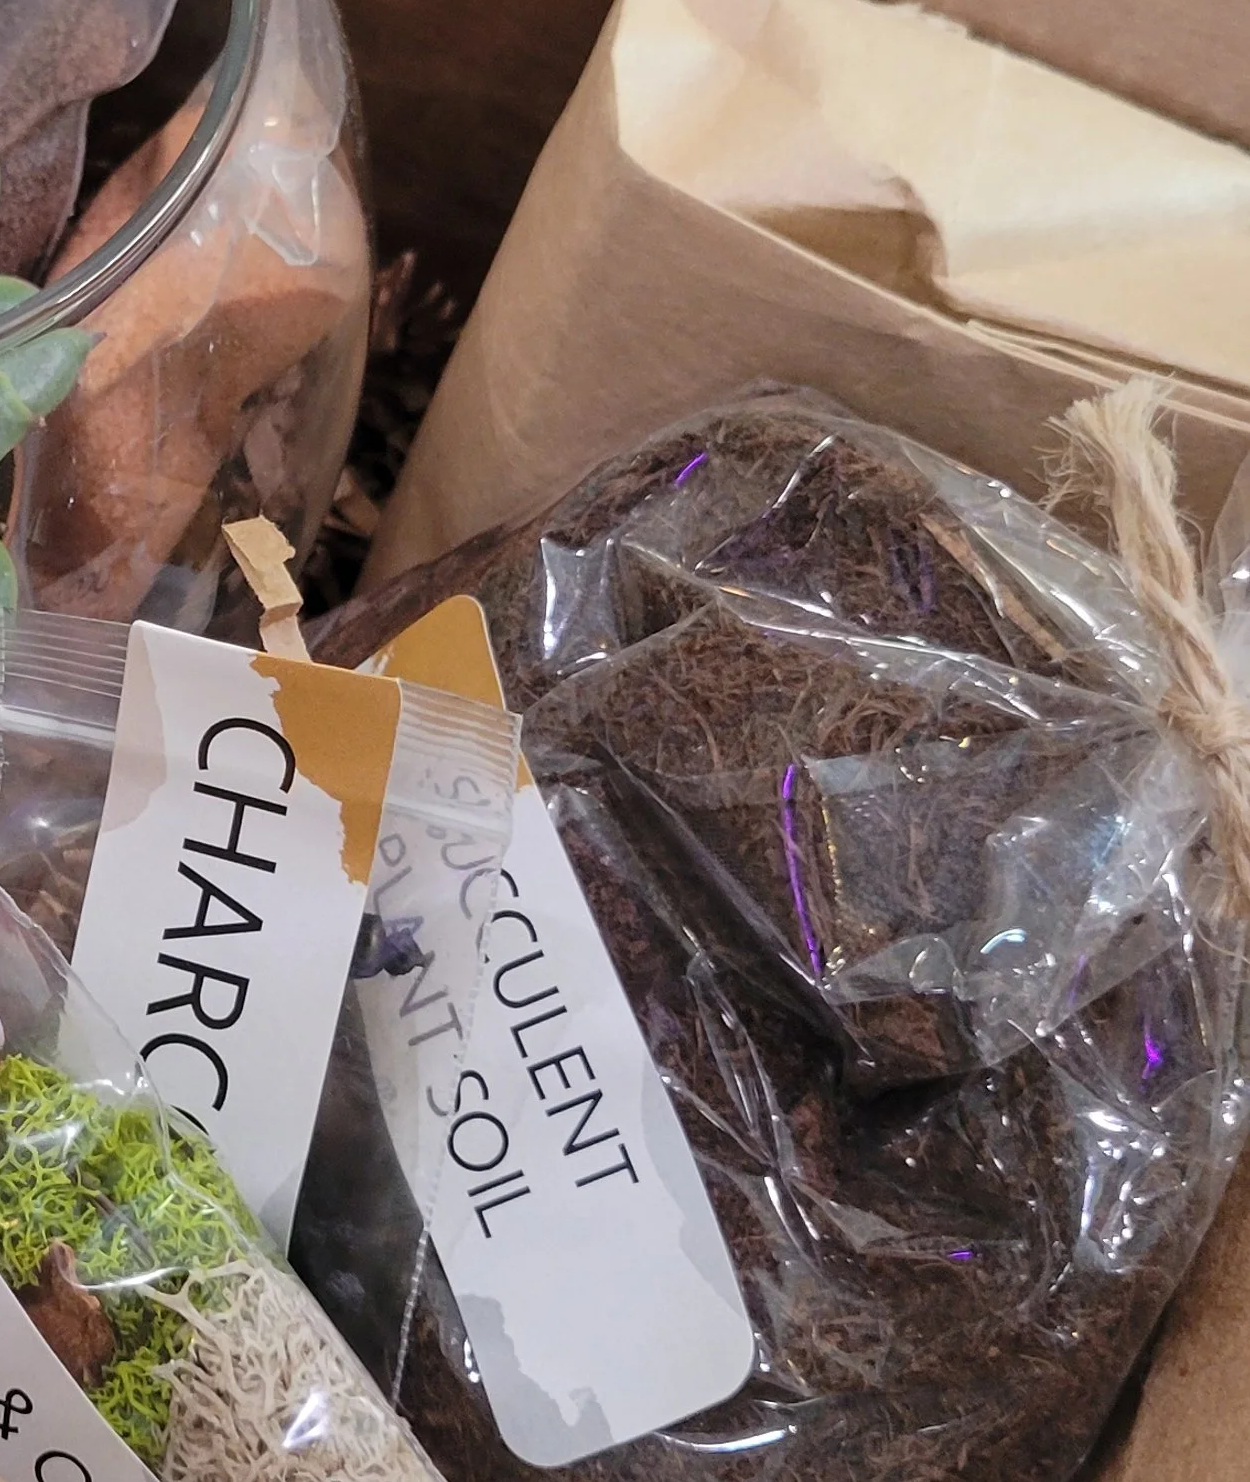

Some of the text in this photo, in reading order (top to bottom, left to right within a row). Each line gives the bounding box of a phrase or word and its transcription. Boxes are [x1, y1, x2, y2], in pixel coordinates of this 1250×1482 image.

[132, 717, 296, 1135] CHARC
[433, 773, 640, 1189] SUCCULENT
[426, 1068, 534, 1239] SOIL
